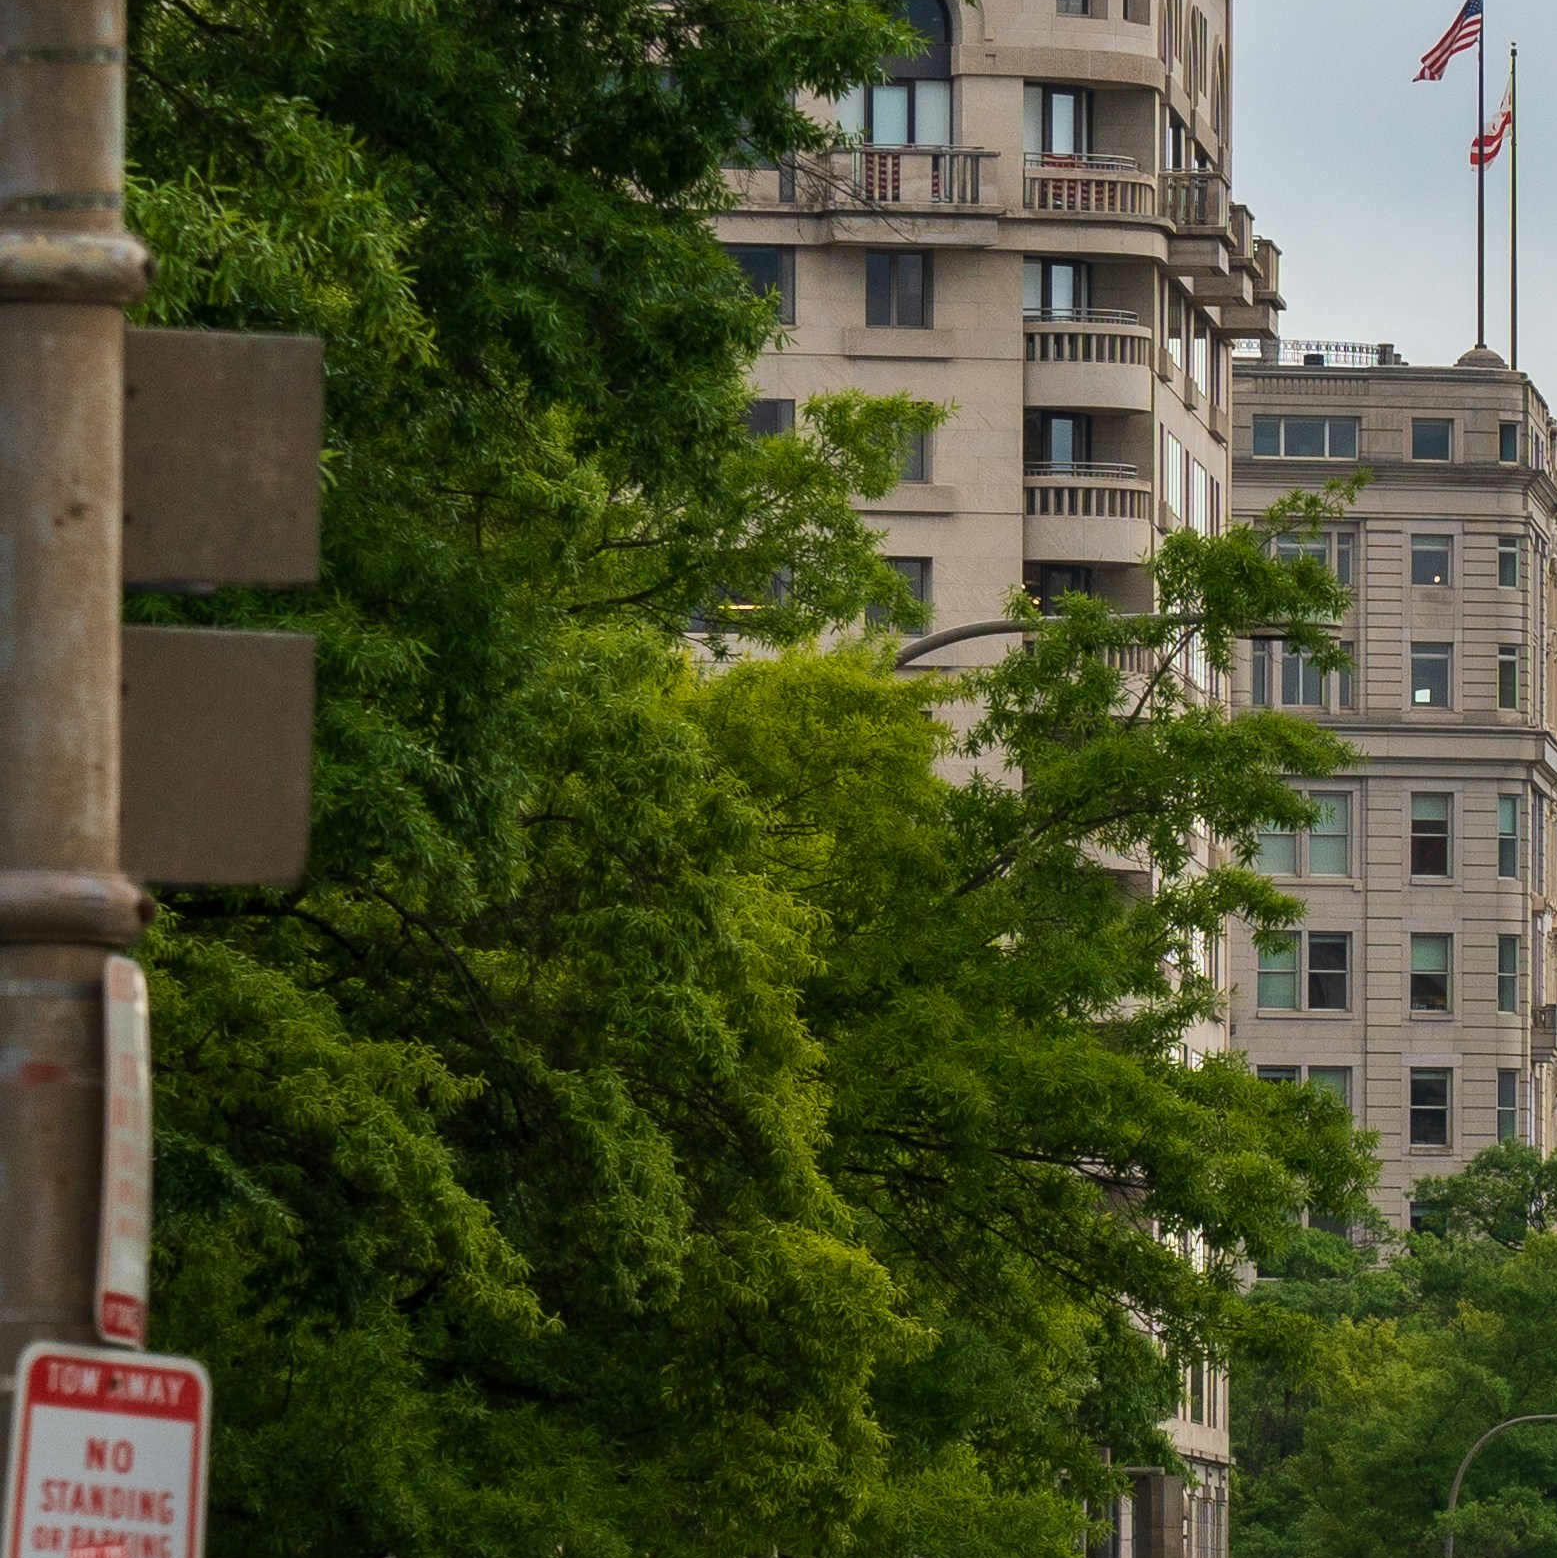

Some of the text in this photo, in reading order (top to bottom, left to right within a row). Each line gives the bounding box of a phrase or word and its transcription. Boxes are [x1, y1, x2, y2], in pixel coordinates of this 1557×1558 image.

[46, 1363, 186, 1406] TOW AWAY
[84, 1437, 135, 1474] NO
[39, 1478, 175, 1525] STANDING
[31, 1525, 63, 1551] OR
